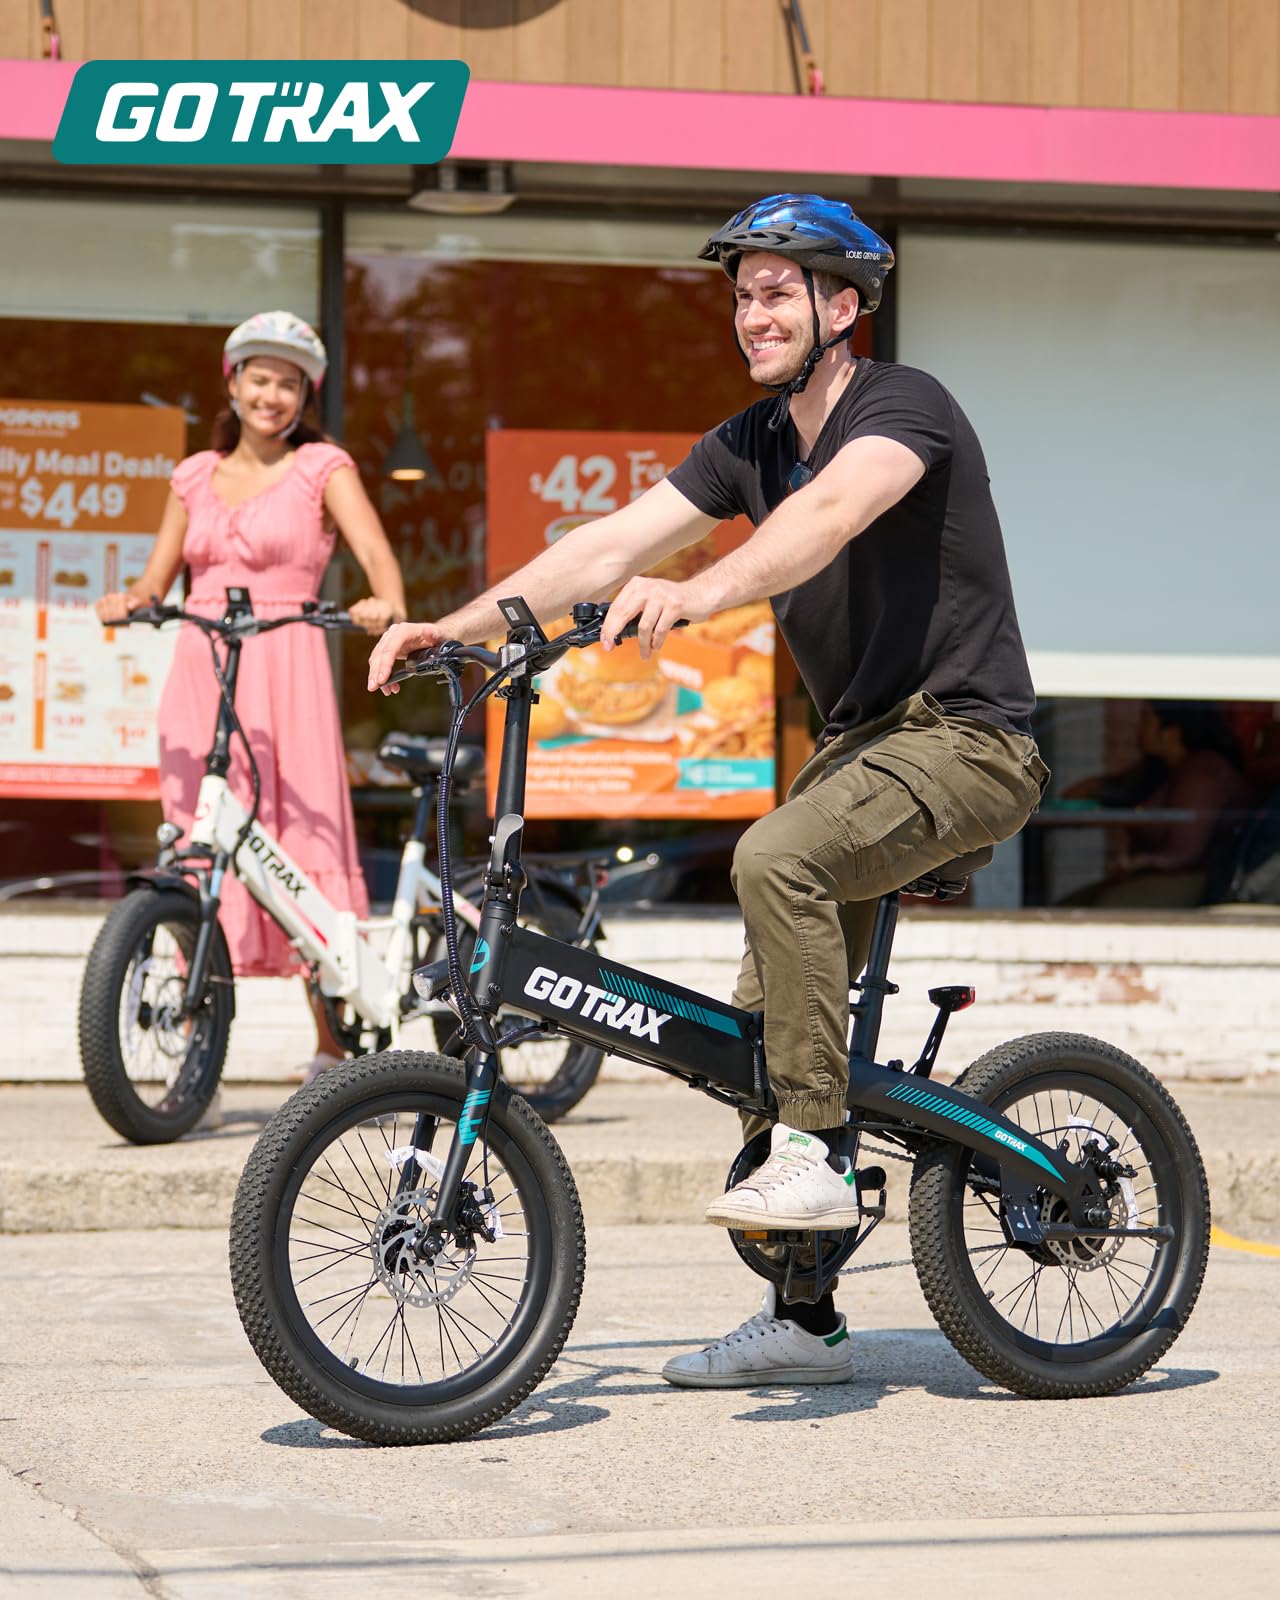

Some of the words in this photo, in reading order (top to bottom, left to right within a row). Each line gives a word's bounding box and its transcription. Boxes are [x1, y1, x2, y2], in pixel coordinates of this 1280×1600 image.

[845, 250, 862, 259] LOUIS
[35, 449, 100, 476] Meal
[994, 1130, 1028, 1152] GOTRAX
